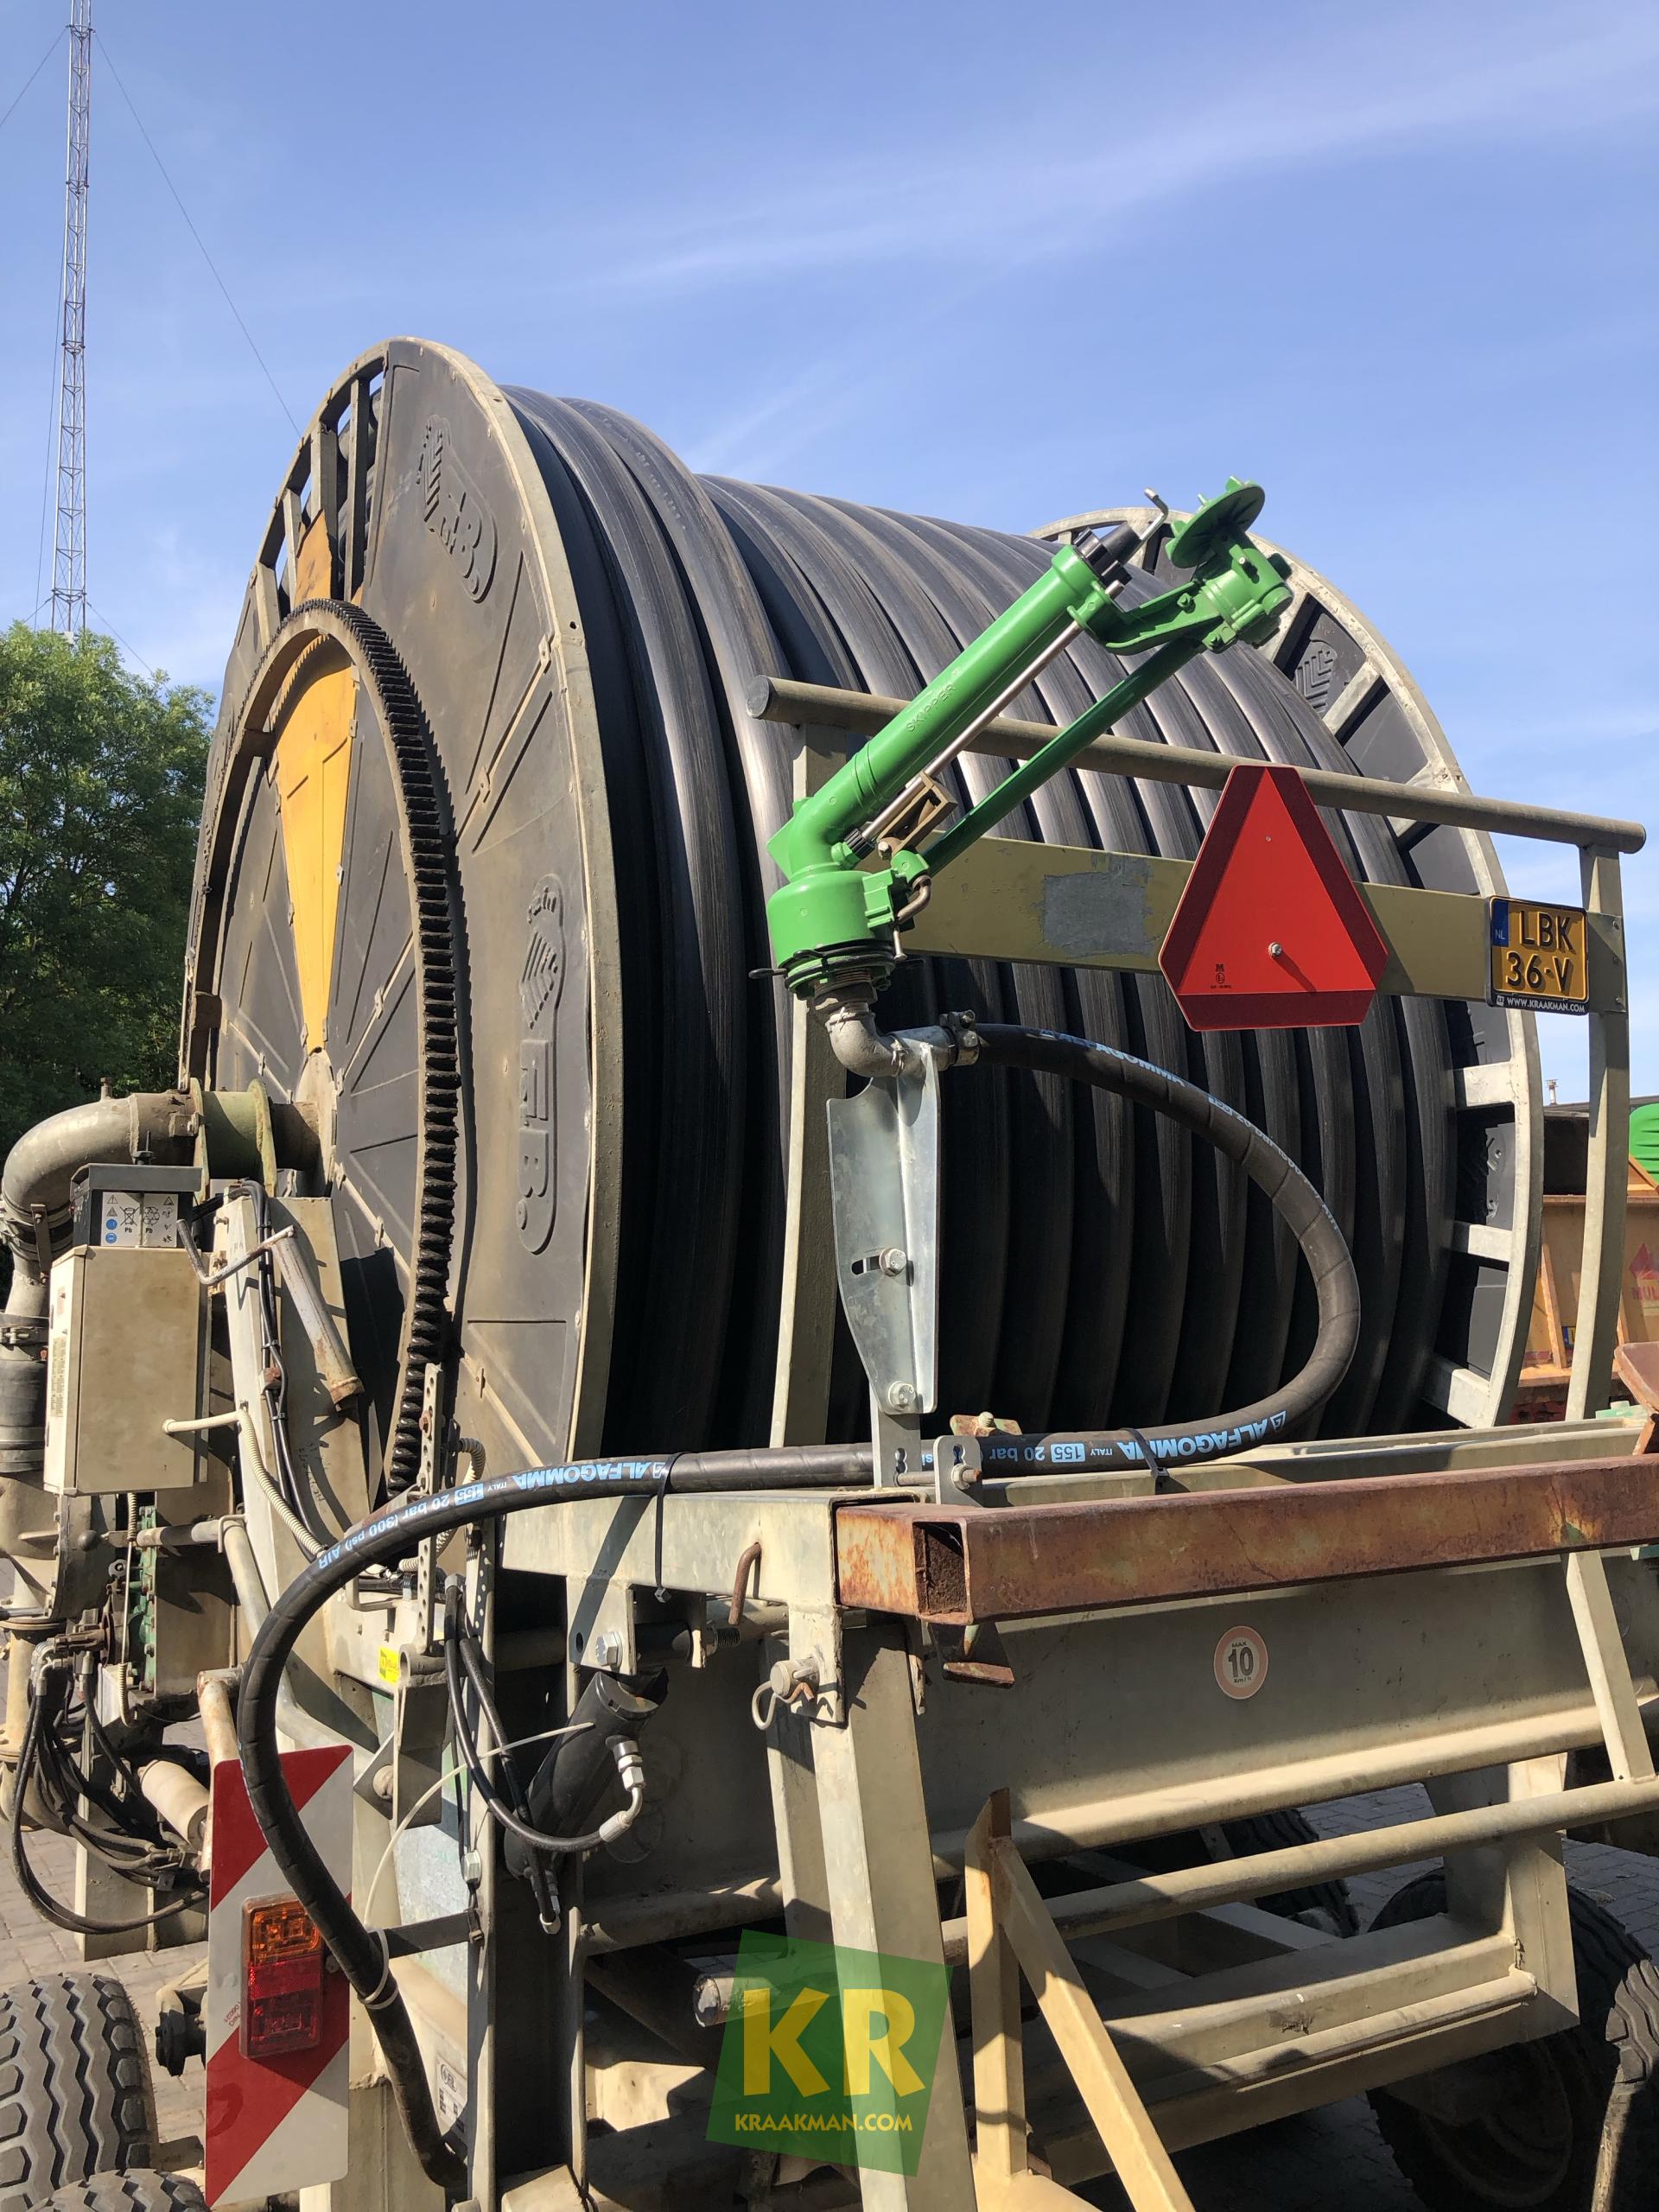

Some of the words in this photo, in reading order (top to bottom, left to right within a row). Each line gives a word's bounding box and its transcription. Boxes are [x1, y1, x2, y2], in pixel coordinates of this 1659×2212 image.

[1495, 929, 1506, 940] NL
[1519, 910, 1576, 955] LBK
[1507, 996, 1586, 1013] WWW.KRAAKMAN.COM
[989, 1446, 1018, 1462] bar
[1024, 1446, 1046, 1462] 20
[1053, 1446, 1081, 1460] 155
[1090, 1447, 1113, 1456] ITALY
[512, 1461, 652, 1491] ALFAGOMMA
[456, 1484, 481, 1503] 155
[486, 1481, 508, 1492] ITALY
[431, 1494, 450, 1510] 20
[402, 1502, 428, 1520] bar
[369, 1514, 398, 1538] (300
[318, 1544, 341, 1570] AIR
[1228, 1646, 1254, 1678] 10
